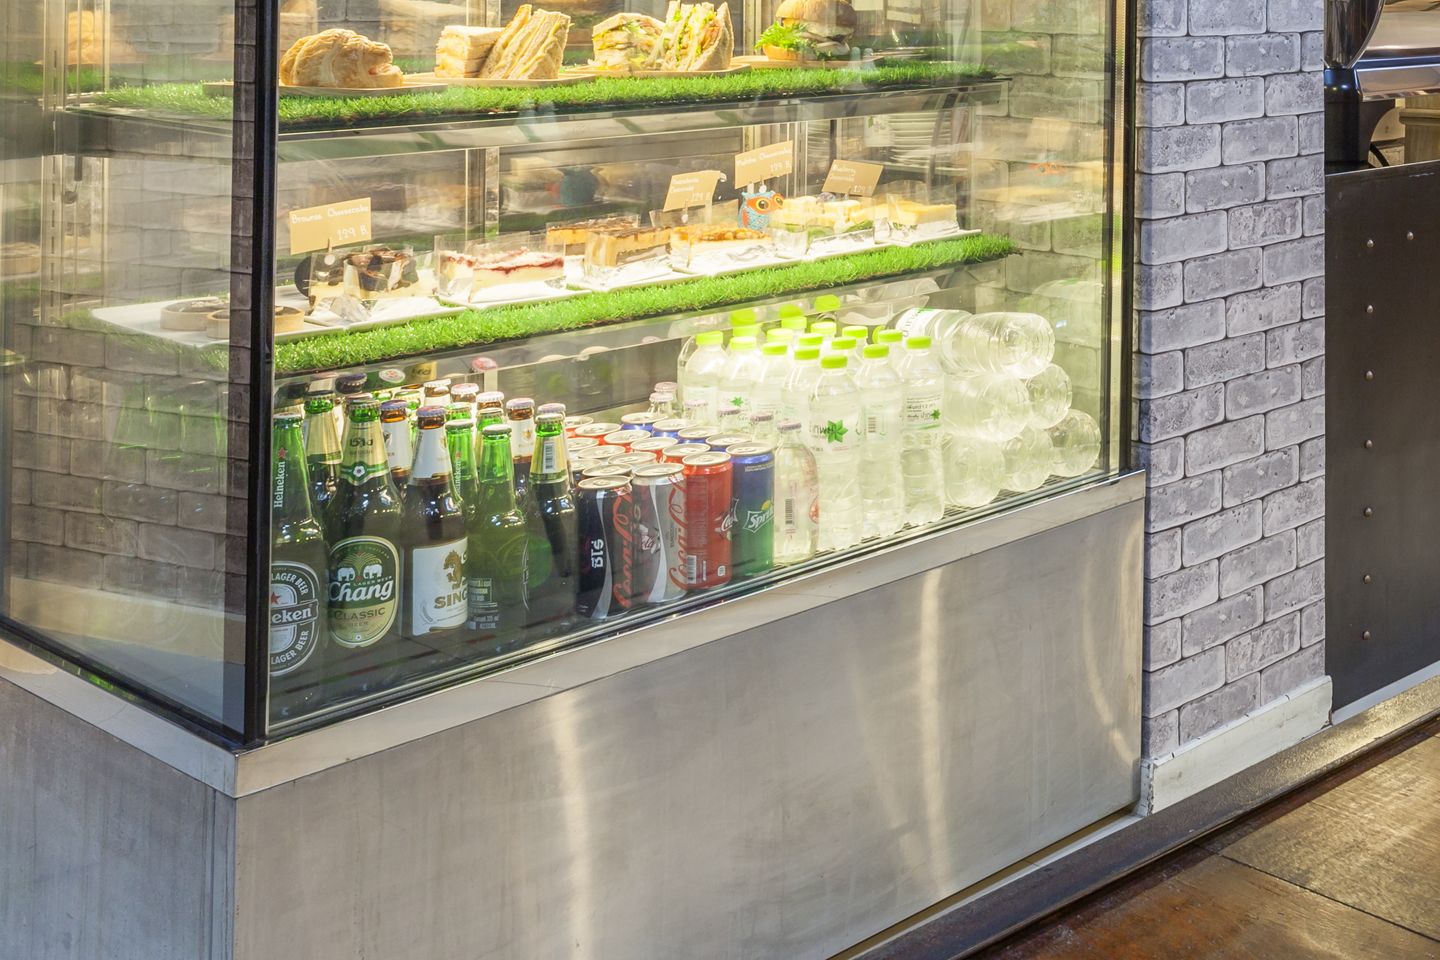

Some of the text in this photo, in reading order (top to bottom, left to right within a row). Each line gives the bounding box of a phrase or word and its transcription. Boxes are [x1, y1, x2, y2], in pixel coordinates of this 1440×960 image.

[273, 461, 286, 508] Heineken
[271, 572, 309, 596] LAGER BEER
[328, 579, 394, 602] Chang
[434, 588, 468, 609] SING
[271, 607, 313, 624] eken
[334, 607, 386, 620] CLASSIC
[271, 630, 309, 665] LAGER BEER
